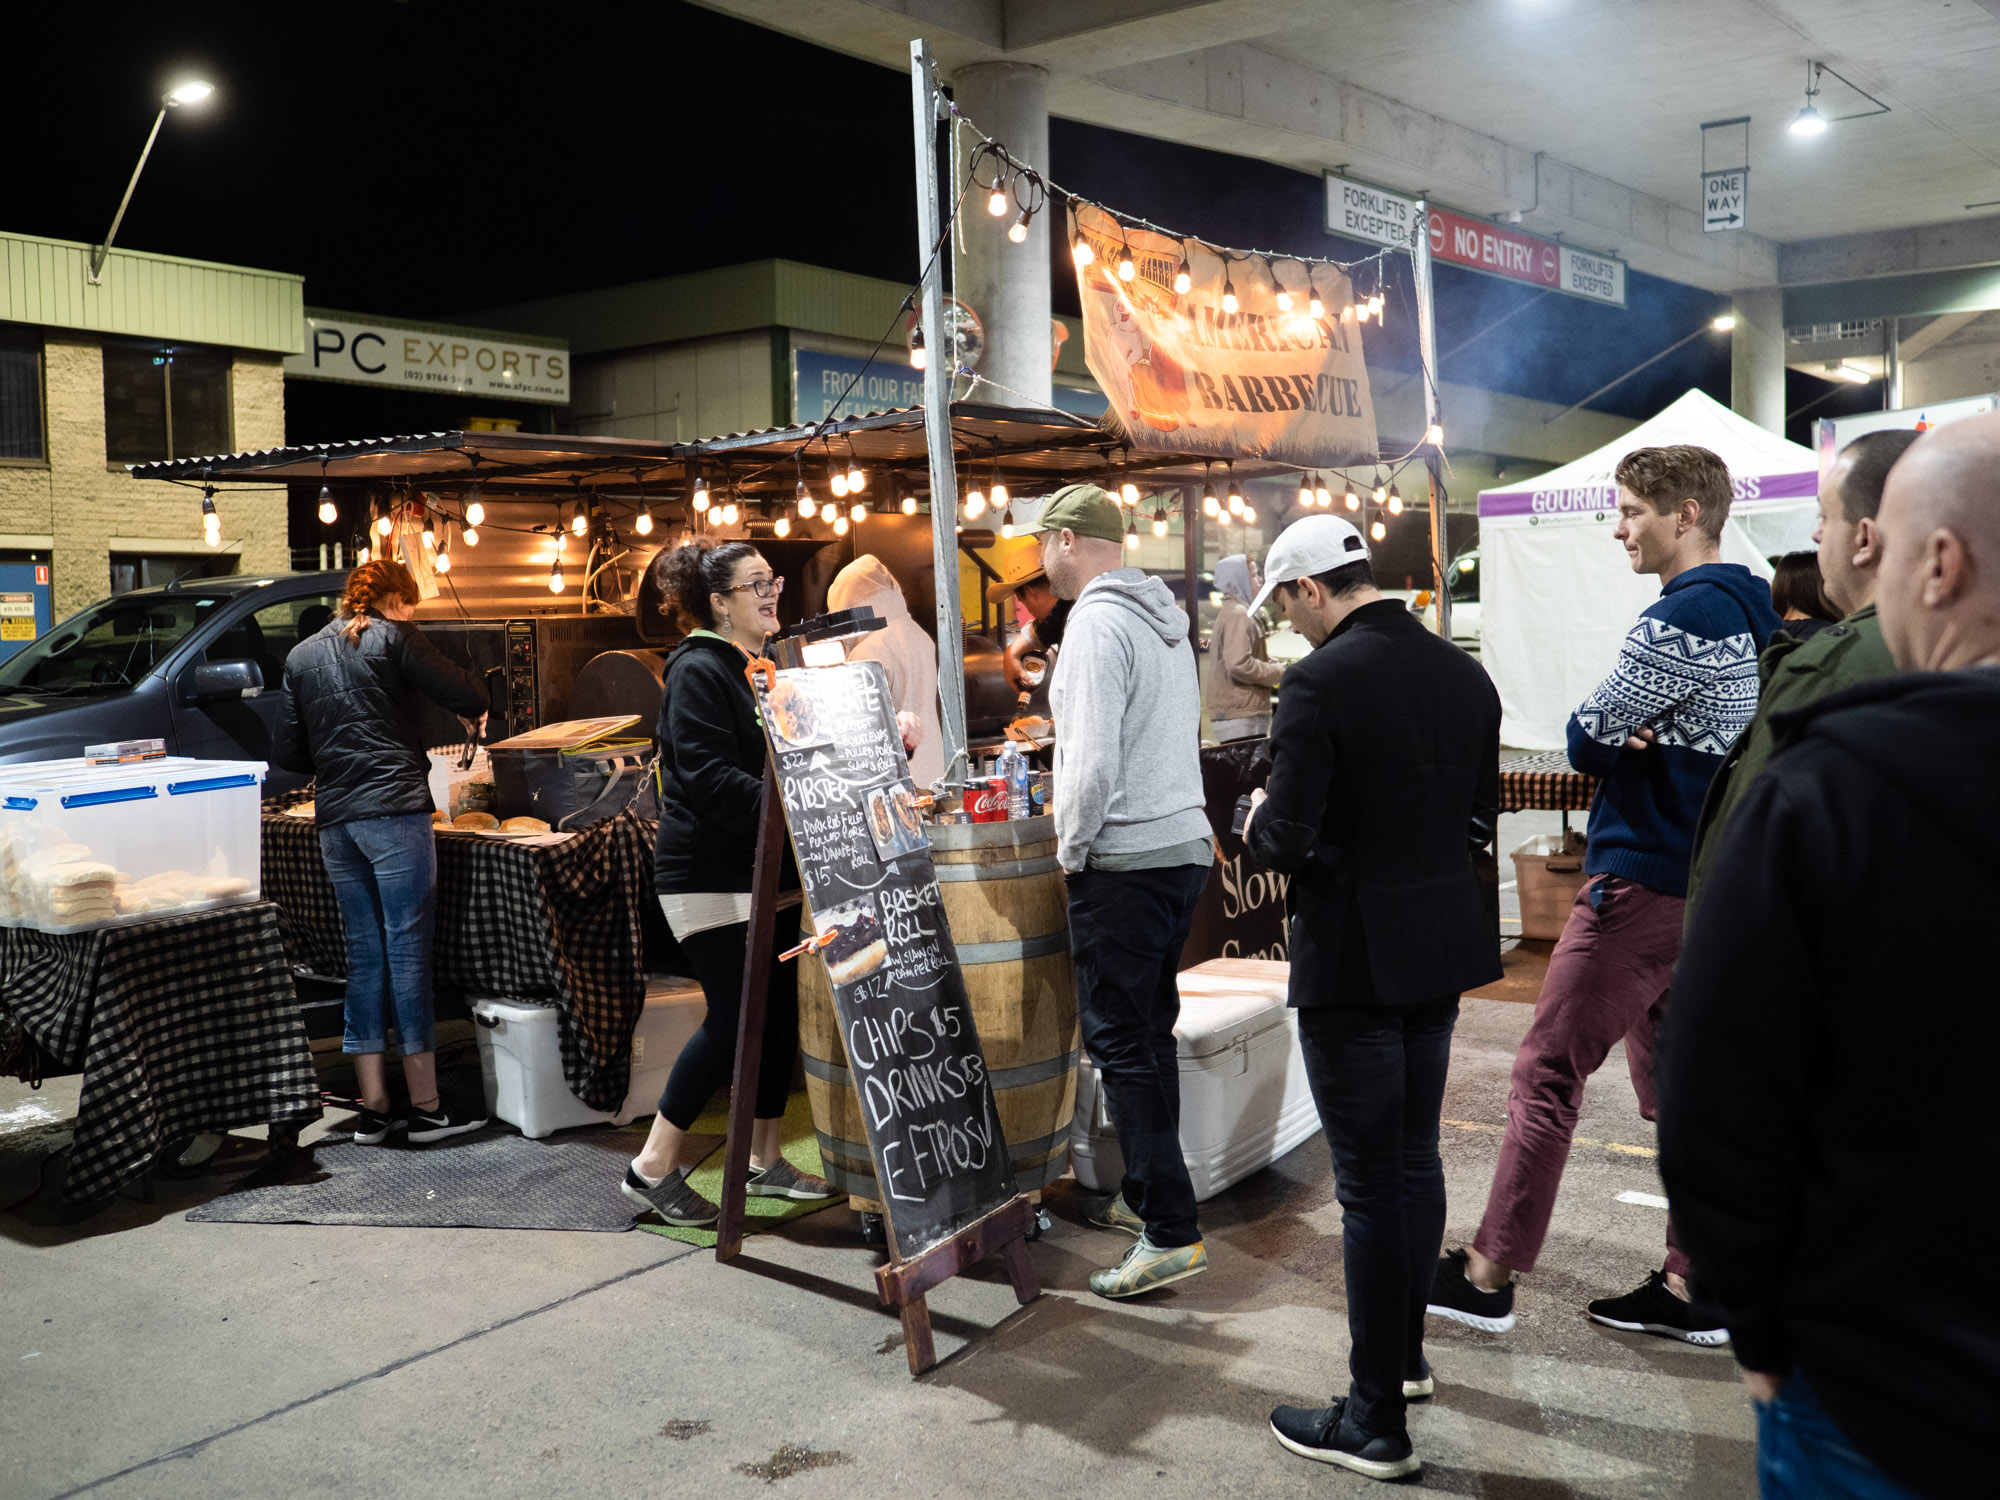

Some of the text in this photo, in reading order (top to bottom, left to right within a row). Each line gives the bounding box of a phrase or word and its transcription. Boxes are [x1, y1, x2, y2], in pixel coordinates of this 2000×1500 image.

[1709, 177, 1739, 193] ONE
[1343, 186, 1406, 221] FORKLIFTS
[1707, 195, 1740, 211] WAY
[1345, 209, 1405, 241] EXCEPTED
[1455, 226, 1533, 273] NO ENTRY
[1571, 254, 1614, 280] FORKLIFTS
[1572, 272, 1613, 297] EXCEPTED
[313, 328, 564, 380] PC EXPORTS
[404, 370, 423, 382] (02)
[427, 373, 448, 383] 9764
[822, 369, 864, 398] FROM
[869, 376, 898, 402] OUR
[1193, 371, 1362, 417] BARBECUE
[782, 753, 807, 770] $22
[784, 776, 857, 812] RIBSTER
[803, 818, 828, 840] PORK
[809, 826, 866, 848] PULLED PORK
[851, 854, 874, 870] ROLL
[803, 865, 831, 891] $15
[1221, 853, 1291, 919] Slow
[880, 878, 940, 917] BRISKET
[884, 915, 937, 946] ROLL
[904, 947, 927, 963] SLAW
[927, 939, 940, 956] ON
[853, 975, 889, 1003] $12
[850, 1005, 961, 1070] CHIPS $5
[864, 1055, 967, 1131] DRINKS
